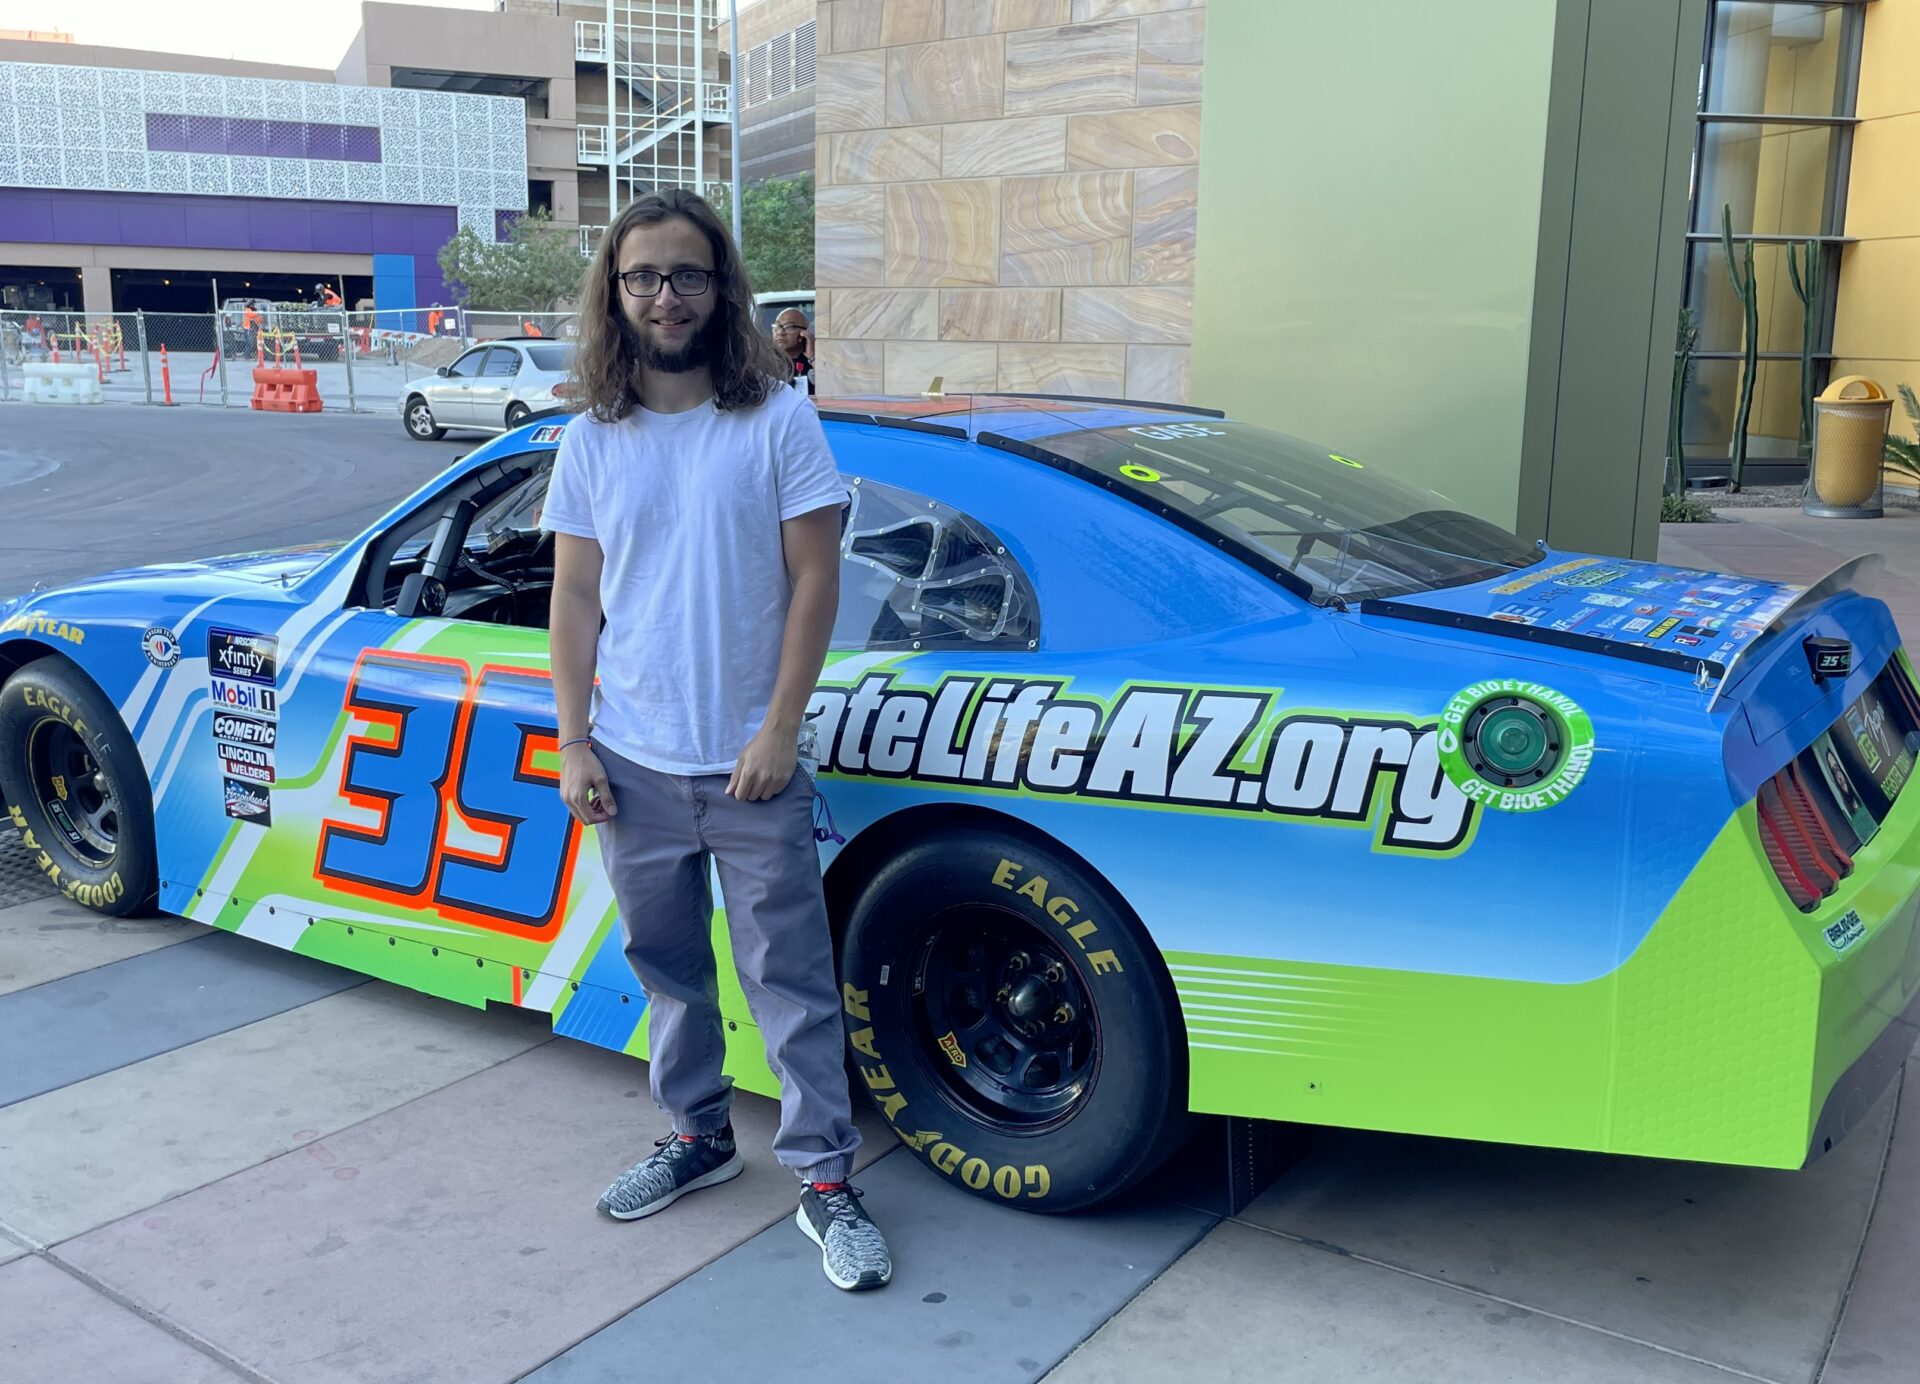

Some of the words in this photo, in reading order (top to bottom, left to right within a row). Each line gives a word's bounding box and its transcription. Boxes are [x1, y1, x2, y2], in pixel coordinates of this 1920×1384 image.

[1127, 423, 1226, 440] GASE
[233, 636, 258, 648] NASCAR
[219, 645, 265, 674] xfinity
[232, 666, 252, 677] SERIES
[1820, 655, 1839, 666] 35
[211, 680, 257, 708] Mobil
[1444, 695, 1472, 724] GET
[1465, 681, 1583, 718] BIOETHANOL
[23, 687, 88, 738] EAGLE
[214, 717, 275, 744] COMETIC
[219, 744, 265, 766] LINCOLN
[230, 762, 271, 781] WELDERS
[1459, 778, 1501, 805] GET
[1499, 738, 1595, 810] BIOETHANOL
[313, 647, 587, 943] 35
[992, 858, 1124, 976] EAGLE
[942, 1039, 964, 1063] AERO
